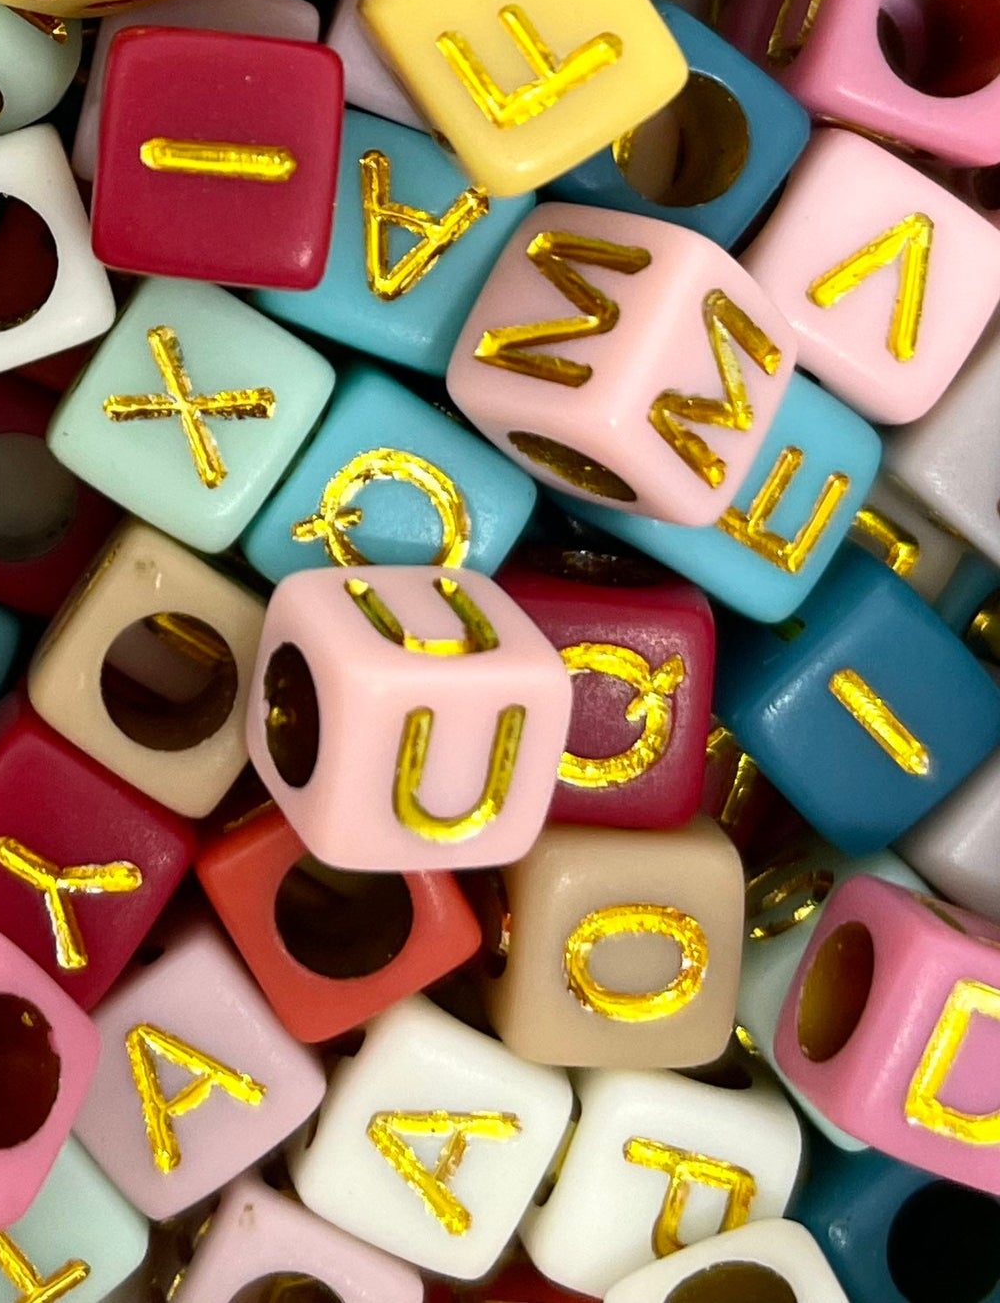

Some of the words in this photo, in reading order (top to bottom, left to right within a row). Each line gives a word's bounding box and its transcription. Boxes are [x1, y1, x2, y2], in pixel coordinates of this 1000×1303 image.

[434, 3, 624, 130] F
[139, 136, 298, 183] I
[358, 148, 492, 301] A
[102, 325, 277, 491] X
[291, 447, 472, 570] Q
[391, 704, 526, 844] U
[555, 640, 686, 790] Q
[563, 902, 710, 1023] O
[124, 1022, 267, 1174] A
[366, 1109, 522, 1237] A
